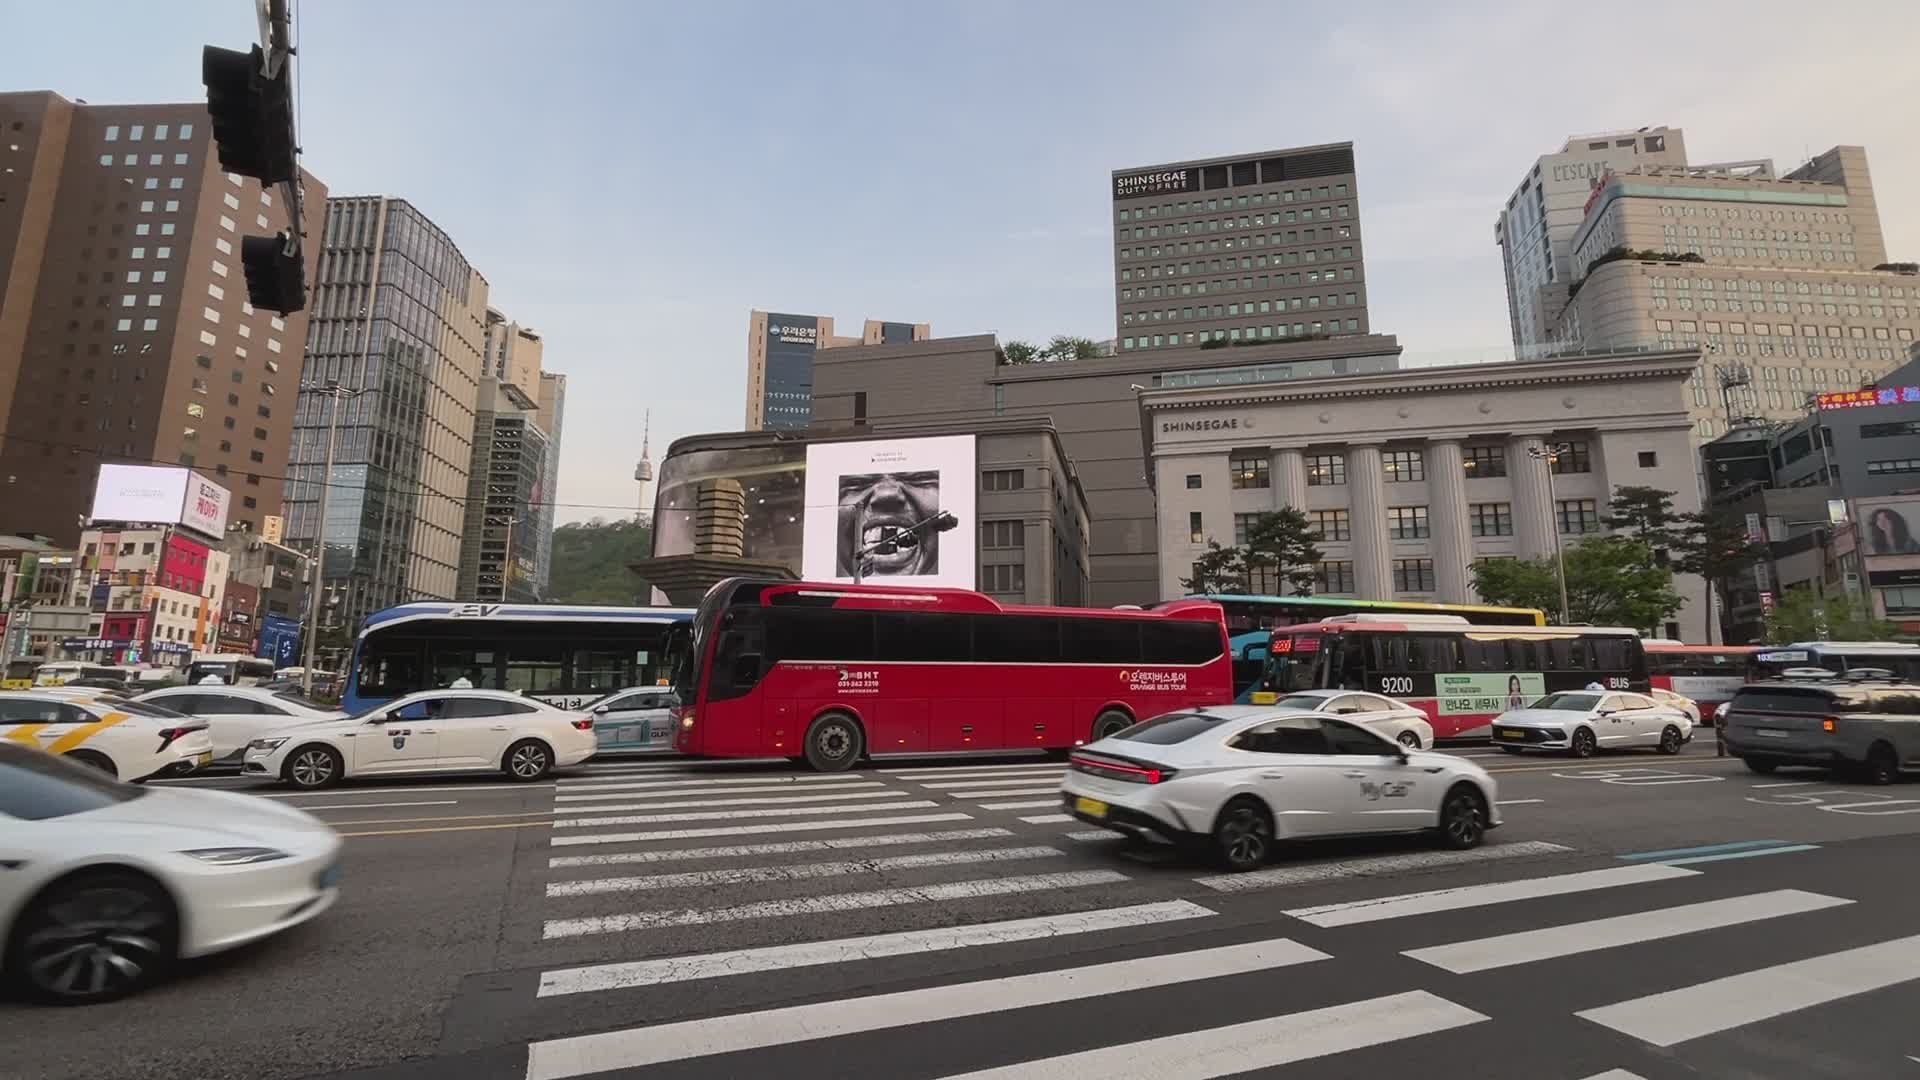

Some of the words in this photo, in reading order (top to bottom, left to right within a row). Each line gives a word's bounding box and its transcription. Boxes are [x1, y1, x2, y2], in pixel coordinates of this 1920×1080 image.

[1117, 170, 1187, 188] SHINSEGAE
[1117, 185, 1147, 195] DUTY
[1156, 181, 1187, 191] FREE
[781, 326, 817, 338] 우리은행
[1162, 418, 1238, 433] SHINSEGAE
[461, 604, 500, 617] EV
[1130, 669, 1187, 684] 오렌지버스투어
[1382, 676, 1413, 694] 9200
